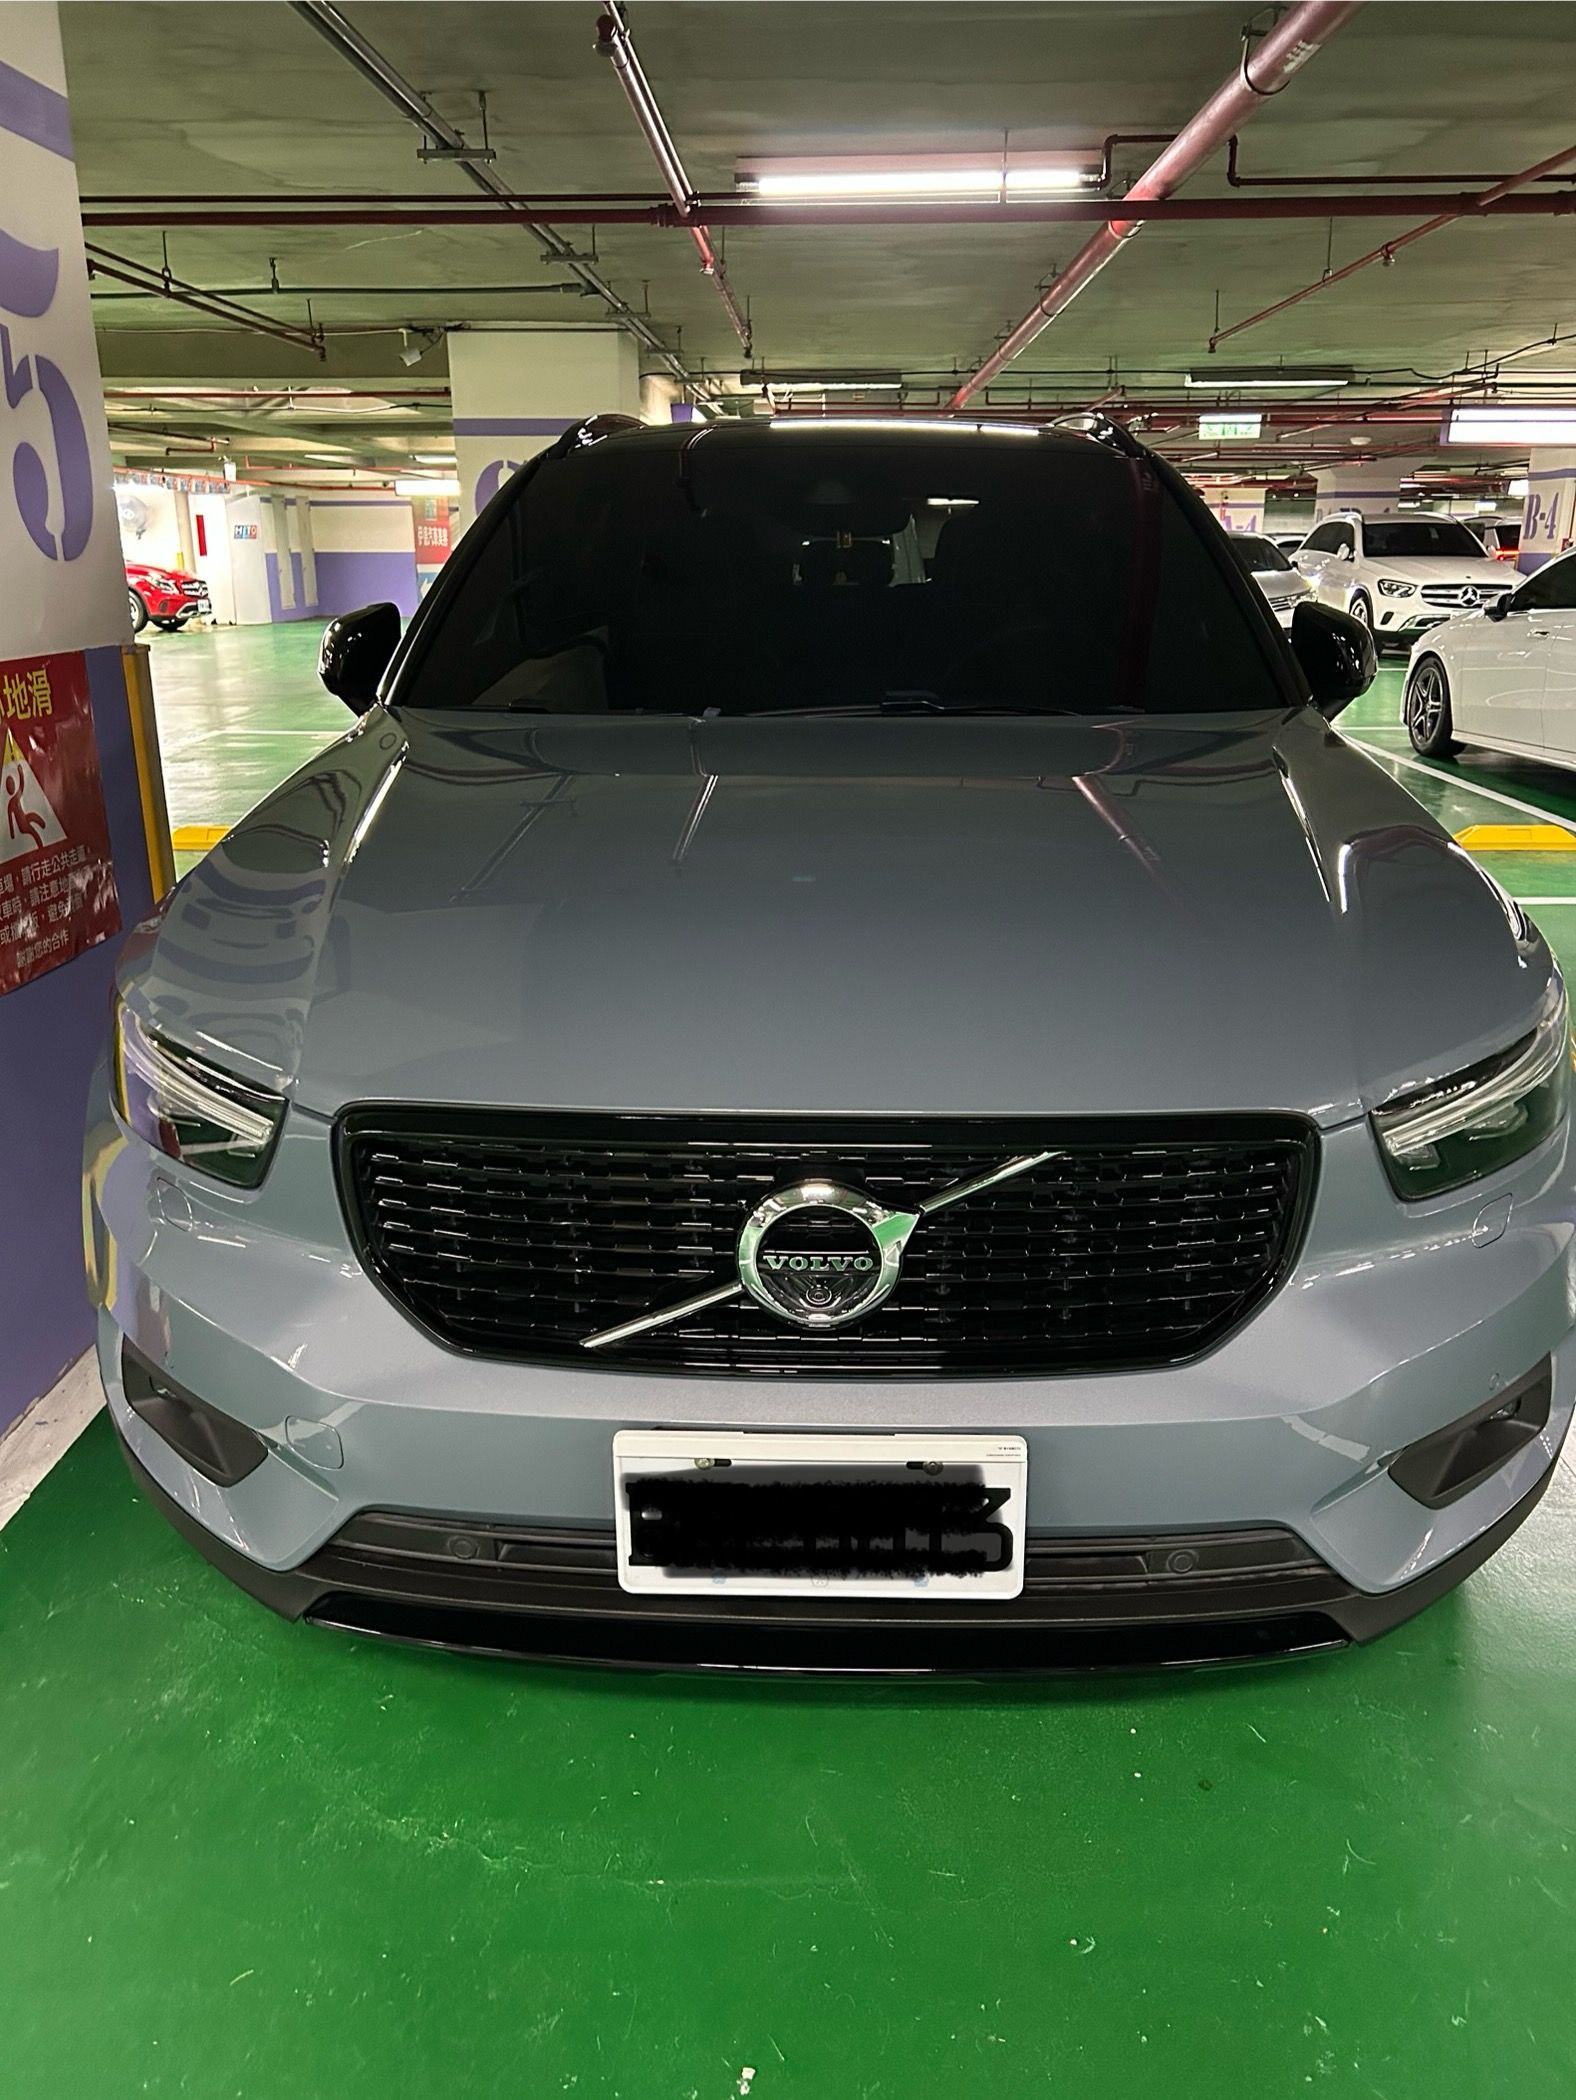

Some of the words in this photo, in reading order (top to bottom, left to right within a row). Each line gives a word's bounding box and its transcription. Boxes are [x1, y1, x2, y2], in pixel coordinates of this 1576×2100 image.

[1523, 492, 1559, 540] B-4
[0, 668, 53, 720] 地滑
[763, 1255, 874, 1272] VOLVO
